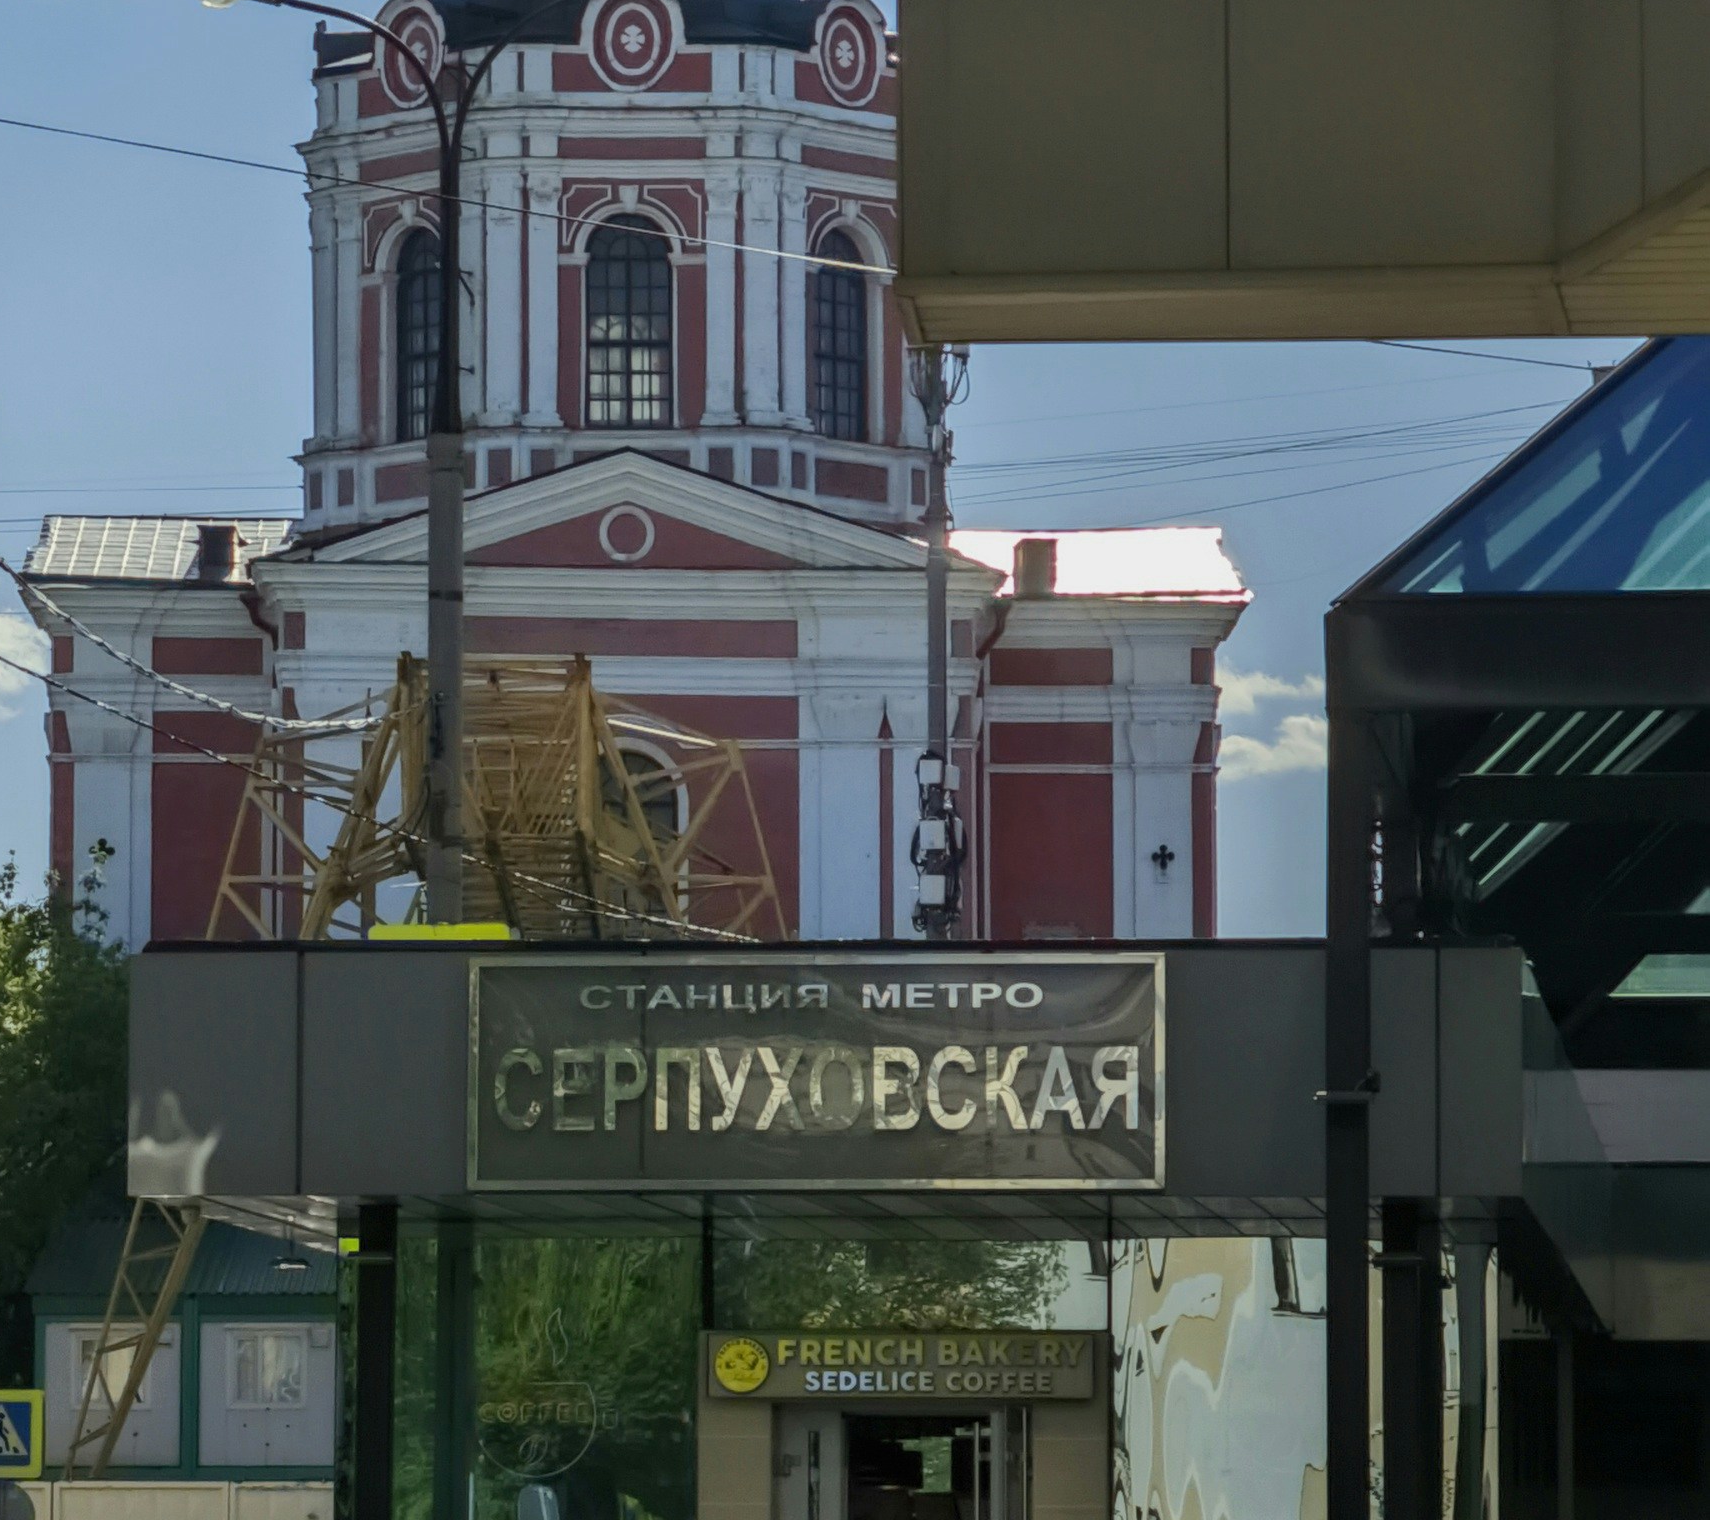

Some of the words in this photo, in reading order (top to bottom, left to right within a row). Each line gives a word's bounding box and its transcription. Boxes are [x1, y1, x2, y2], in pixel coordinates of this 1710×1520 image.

[579, 983, 829, 1014] СТАНЦИЯ
[861, 982, 1044, 1010] МЕТРО
[494, 1044, 1140, 1133] СЕРПУХОВСКАЯ
[777, 1339, 924, 1368] FRENCH
[936, 1338, 1086, 1368] BAKERY
[804, 1370, 935, 1393] SEDELICE
[945, 1370, 1054, 1394] COFFEE
